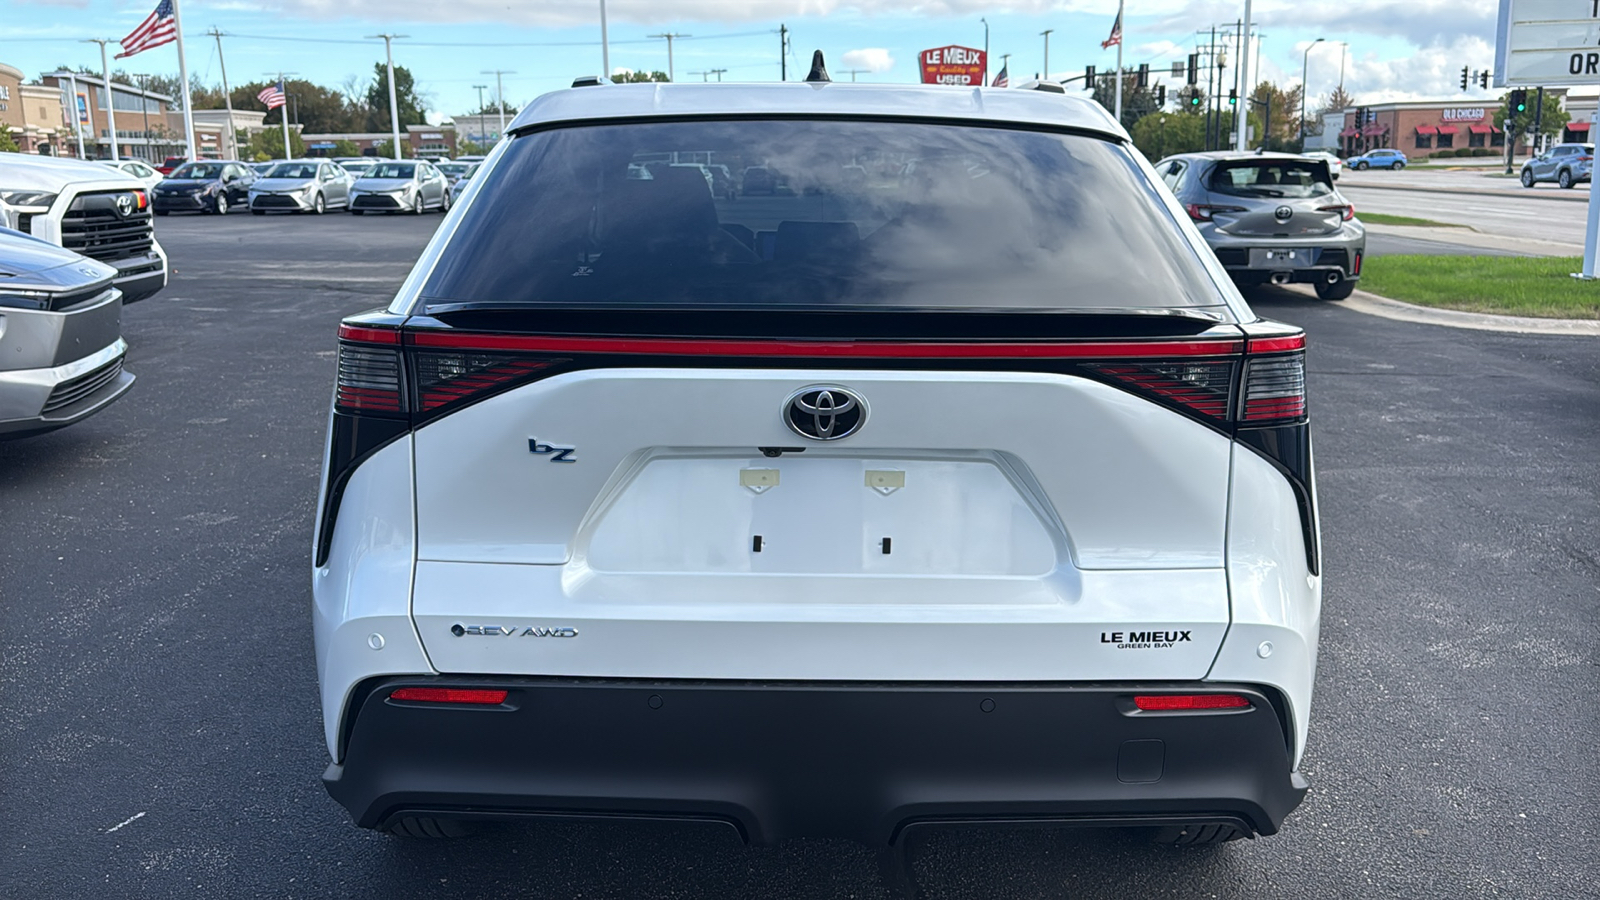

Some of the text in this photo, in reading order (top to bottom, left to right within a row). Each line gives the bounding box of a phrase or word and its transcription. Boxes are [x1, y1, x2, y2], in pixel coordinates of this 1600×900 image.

[926, 47, 980, 65] LE MIEUX
[1569, 53, 1599, 75] OR
[936, 74, 971, 84] USED
[1443, 108, 1485, 119] OLD CHICAGO
[466, 625, 579, 638] BEV AWD
[1101, 630, 1192, 643] LE MIEUX
